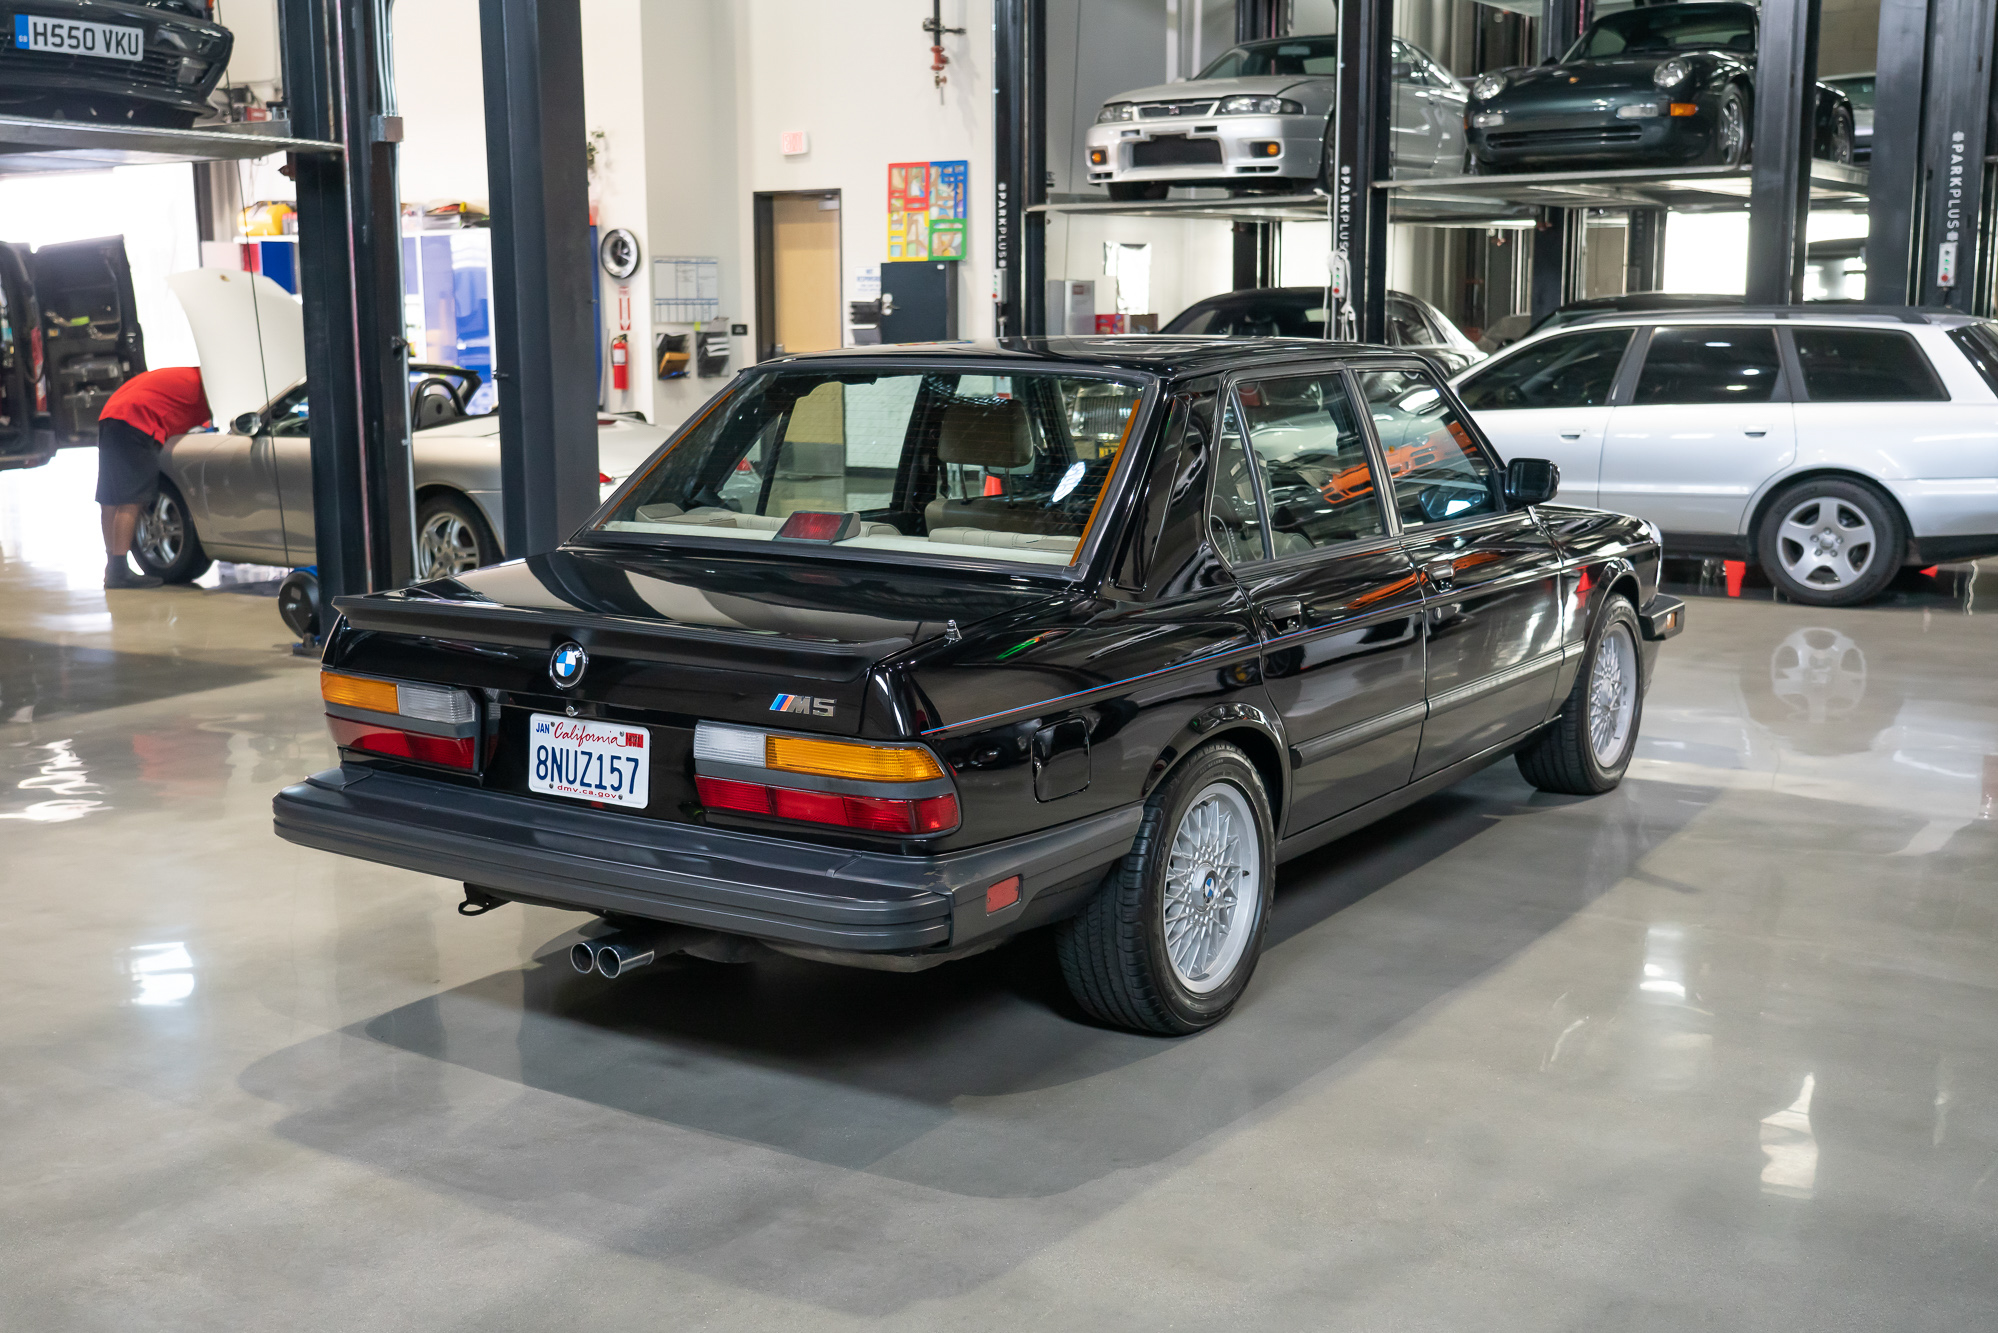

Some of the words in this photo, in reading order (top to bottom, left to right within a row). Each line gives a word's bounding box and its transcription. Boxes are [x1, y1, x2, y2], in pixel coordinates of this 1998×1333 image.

[33, 21, 96, 52] H550
[102, 28, 140, 56] VKU
[1946, 143, 1964, 229] PARKPLUS
[998, 192, 1007, 258] PARKPLUS
[1339, 176, 1351, 250] PARKPLUS
[535, 722, 550, 734] JAN
[554, 721, 626, 747] California
[536, 744, 640, 795] 8NUZ157
[557, 785, 617, 799] dmv.ca.gov
